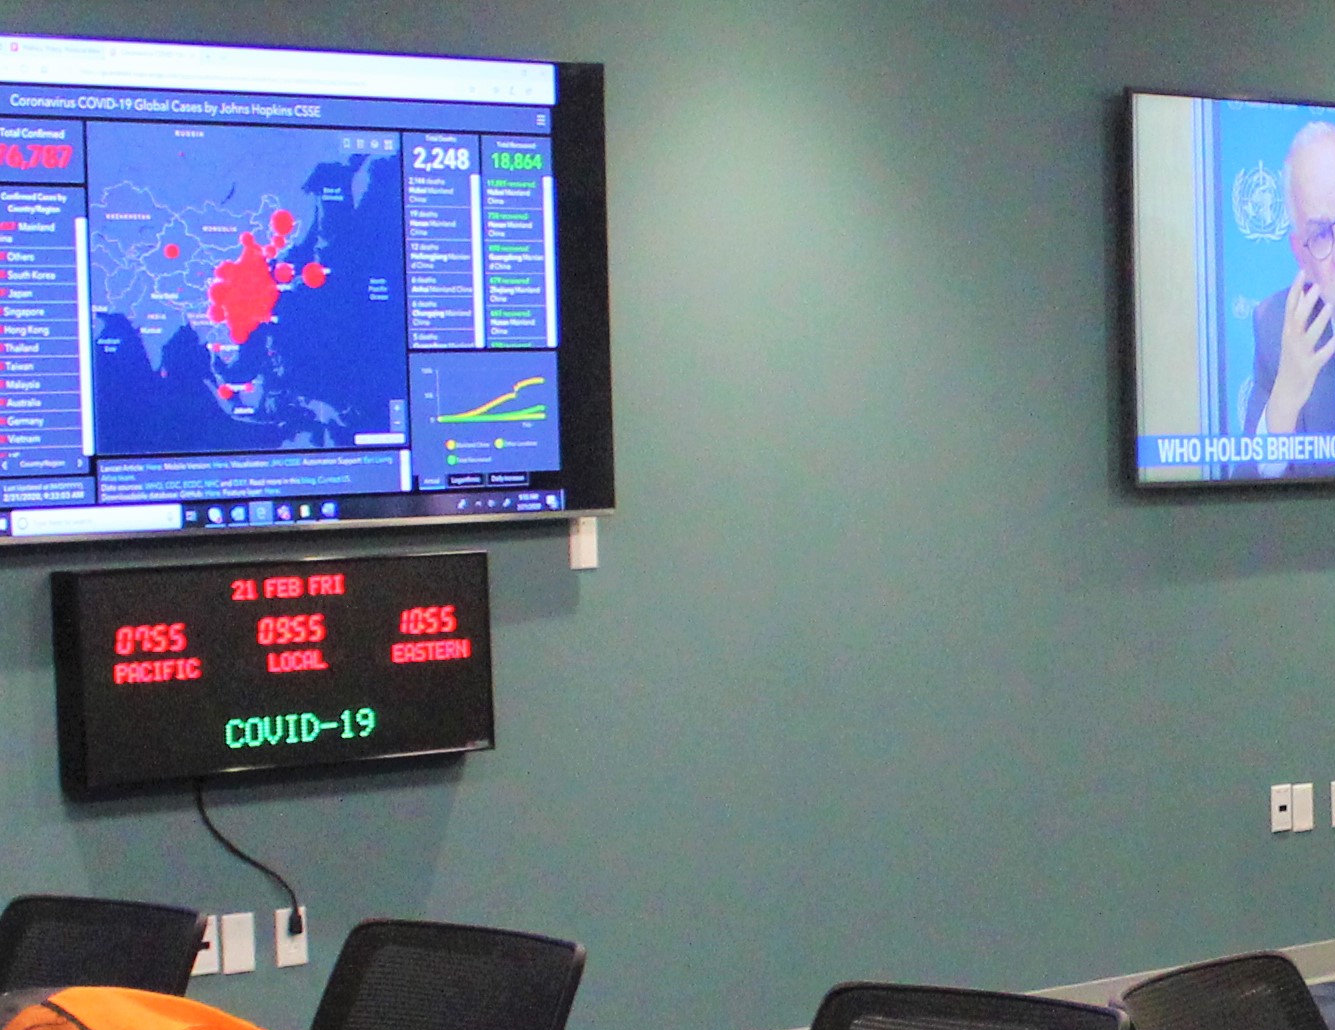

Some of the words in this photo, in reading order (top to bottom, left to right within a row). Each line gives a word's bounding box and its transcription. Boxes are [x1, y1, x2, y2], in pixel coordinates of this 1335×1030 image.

[10, 93, 76, 109] Coronavirus
[78, 96, 132, 111] COVID-19
[134, 98, 169, 112] Global
[171, 100, 203, 114] Cases
[204, 101, 218, 116] by
[220, 103, 249, 115] Johns
[251, 104, 293, 118] Hopkins
[294, 105, 321, 118] CSSE
[0, 127, 20, 138] Total
[21, 128, 65, 140] Confirmed
[413, 146, 470, 171] 2,248
[491, 152, 543, 171] 18,864
[18, 221, 55, 232] Mainland
[6, 252, 35, 262] Others
[7, 270, 30, 280] South
[31, 270, 56, 280] Korea
[8, 289, 33, 299] Japan
[3, 306, 45, 318] Singapore
[4, 325, 27, 336] Hong
[28, 325, 50, 336] Kong
[4, 343, 40, 353] Thailand
[6, 361, 34, 371] Taiwan
[6, 380, 41, 391] Malaysia
[6, 398, 42, 408] Australia
[6, 416, 44, 427] Germany
[7, 434, 41, 444] Vietnam
[1157, 438, 1201, 463] WHO
[1205, 437, 1263, 462] HOLDS
[72, 491, 85, 500] AM
[231, 579, 259, 601] 21
[263, 577, 301, 599] FEB
[308, 574, 345, 596] FRI
[390, 638, 472, 664] EASTERN
[266, 649, 329, 673] LOCAL
[113, 657, 203, 685] PACIFIC
[225, 707, 376, 748] COVID-19
